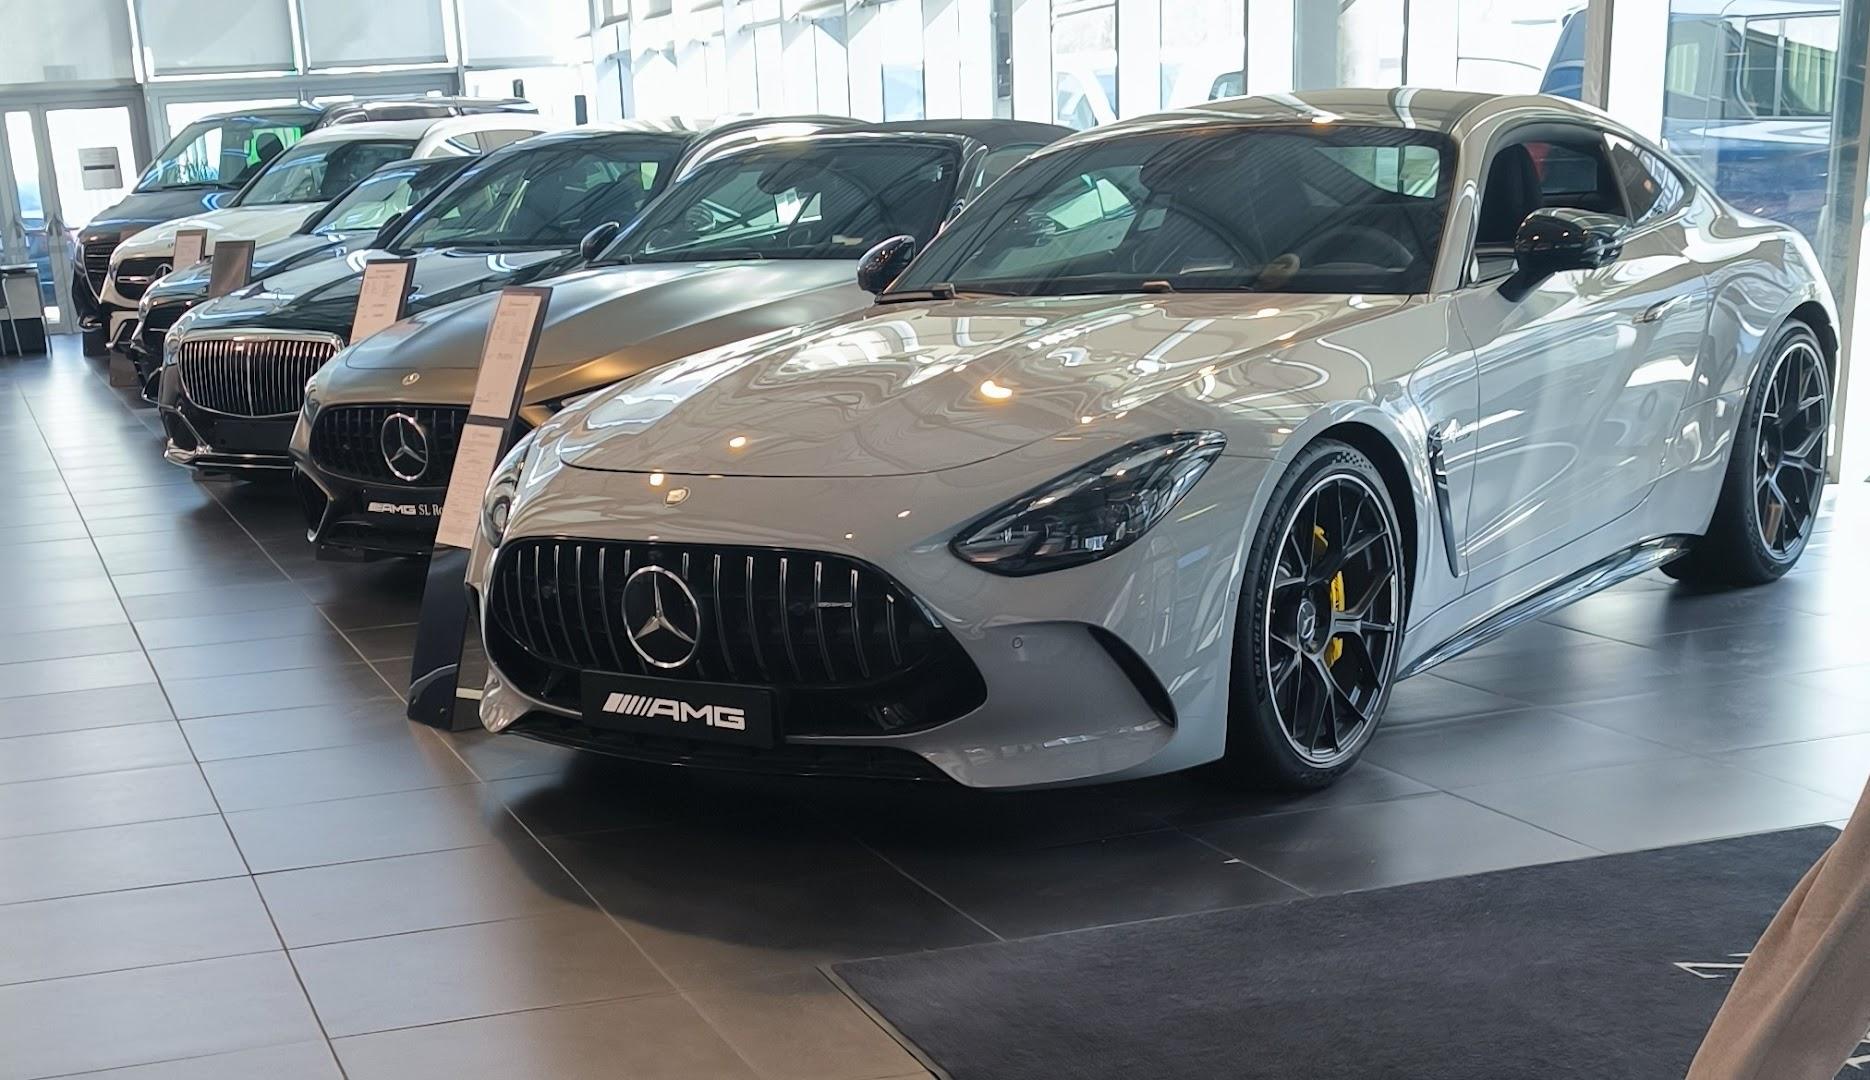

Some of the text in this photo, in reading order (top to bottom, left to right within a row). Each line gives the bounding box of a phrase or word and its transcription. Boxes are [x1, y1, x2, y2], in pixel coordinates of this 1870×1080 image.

[381, 503, 417, 516] AMG
[418, 503, 431, 516] SL
[1254, 588, 1264, 677] MICHELIN
[644, 698, 746, 731] AMG
